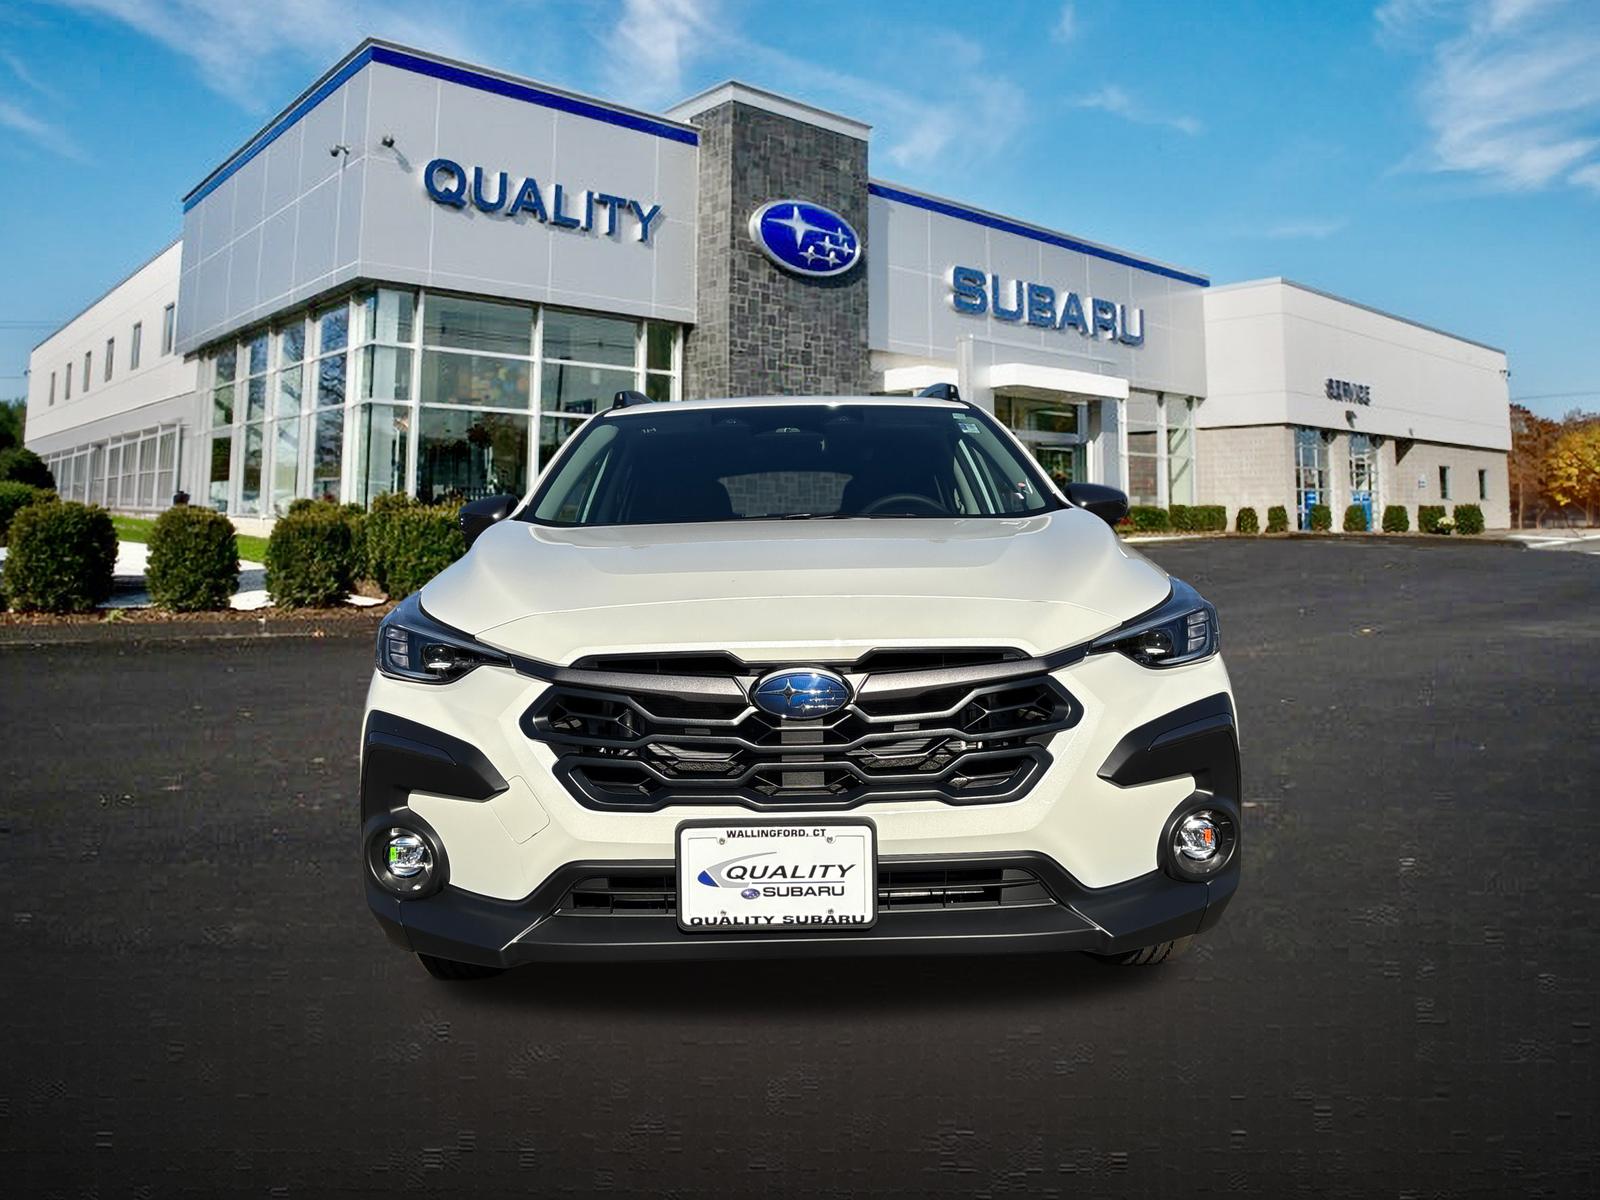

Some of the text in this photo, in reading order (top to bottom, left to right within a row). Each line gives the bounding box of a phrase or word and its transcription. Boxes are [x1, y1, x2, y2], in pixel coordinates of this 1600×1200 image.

[424, 158, 661, 242] QUALITY
[951, 265, 1145, 347] SUBARU
[813, 829, 826, 837] CT
[726, 864, 856, 880] QUALITY
[763, 886, 845, 897] SUBARU
[690, 914, 865, 926] QUALITY SUBARU
